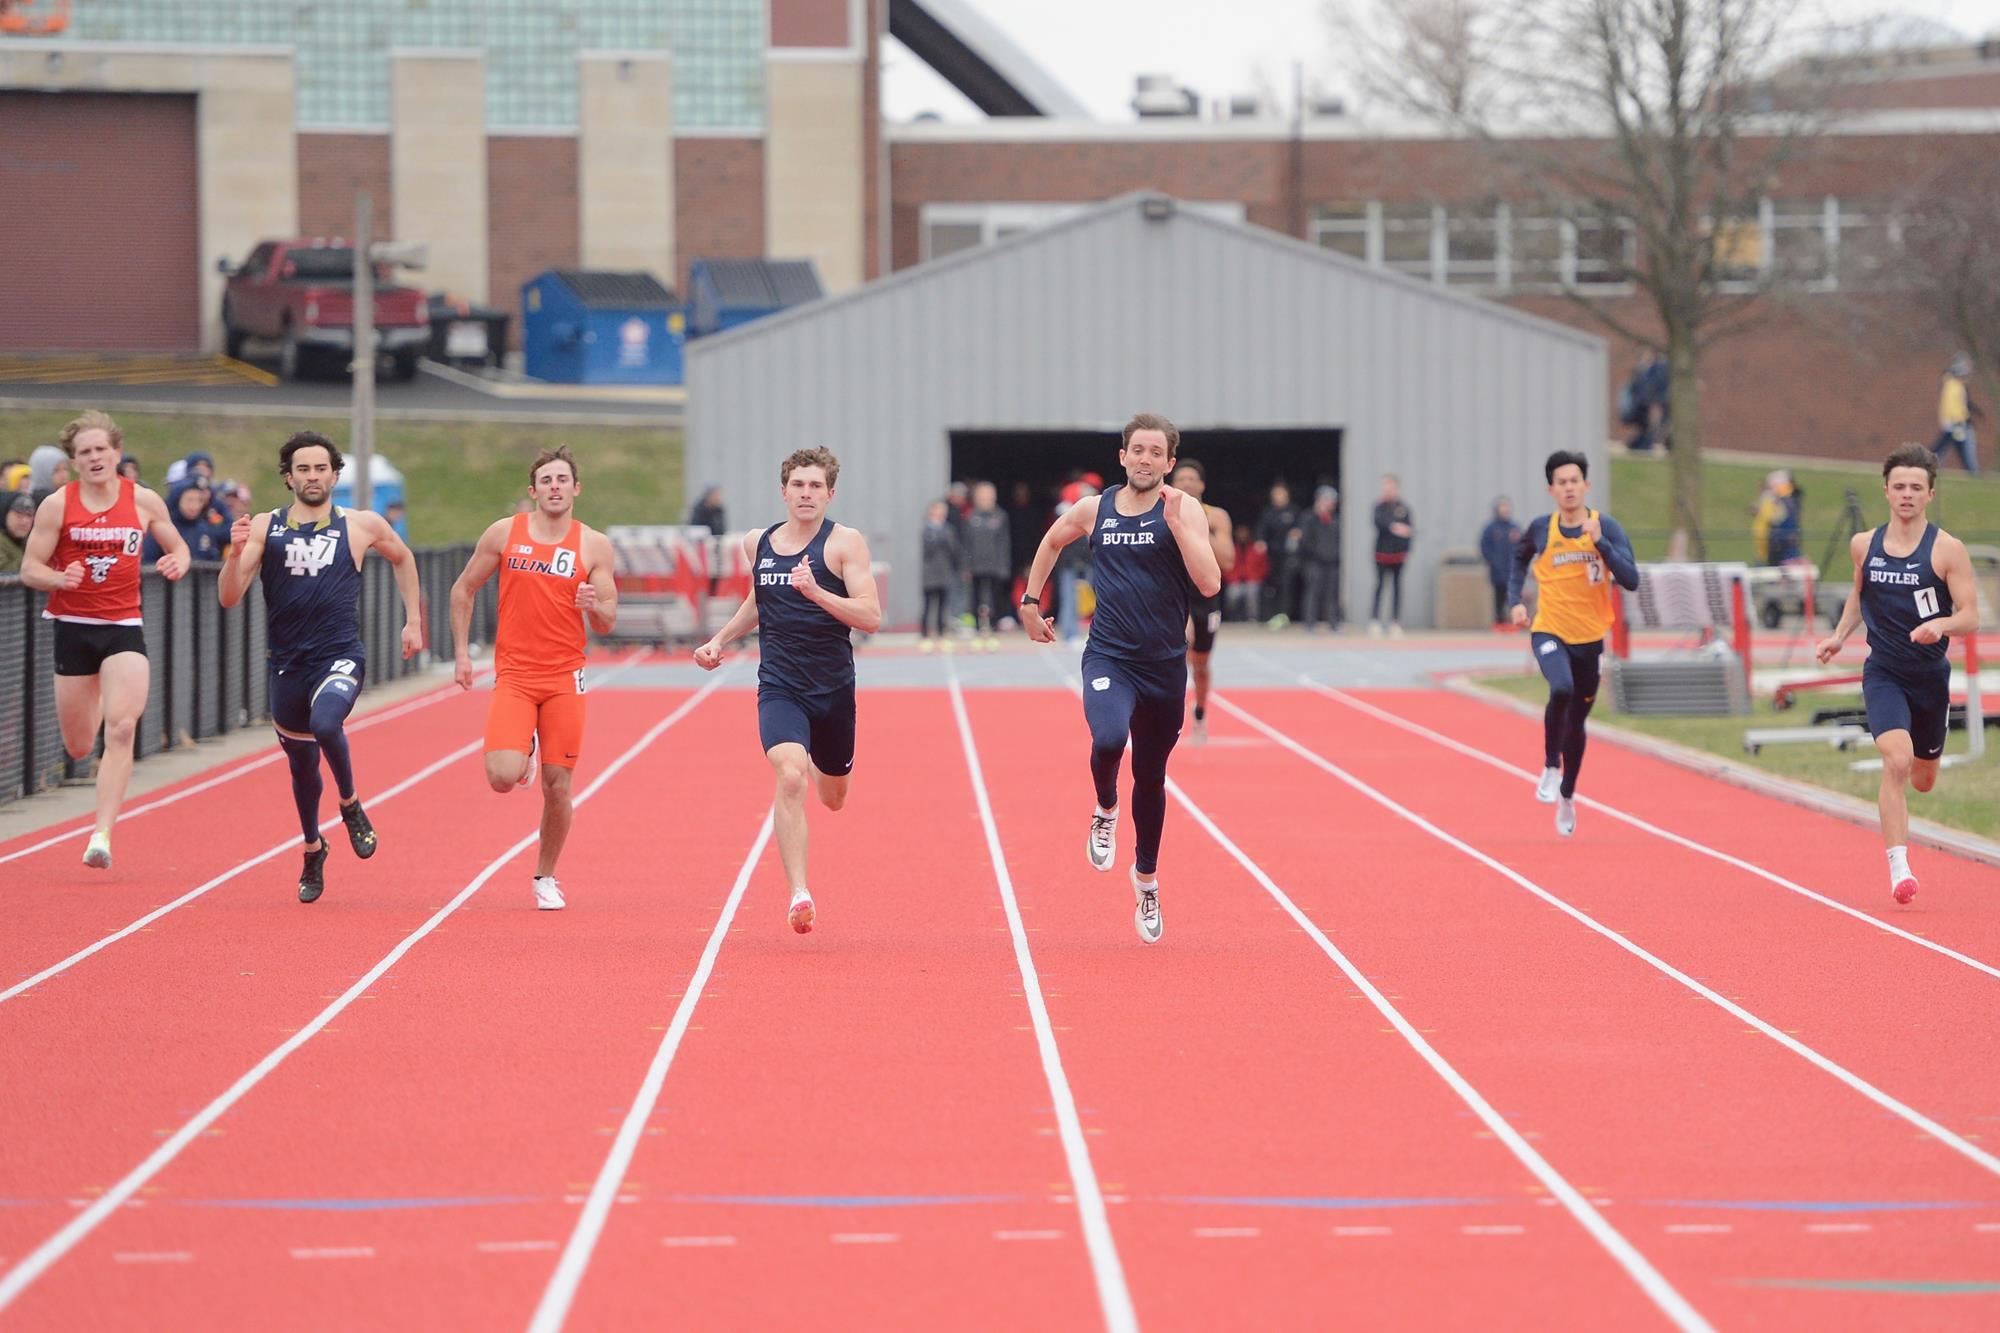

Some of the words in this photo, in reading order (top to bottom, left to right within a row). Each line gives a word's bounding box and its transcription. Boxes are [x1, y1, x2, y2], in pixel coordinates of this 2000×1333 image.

[128, 531, 139, 553] 8
[319, 537, 332, 560] 7
[1102, 532, 1155, 545] BUTLER
[556, 551, 570, 573] 6
[760, 573, 793, 586] BUTL
[1870, 570, 1920, 586] BUTLER
[1921, 591, 1933, 613] 1
